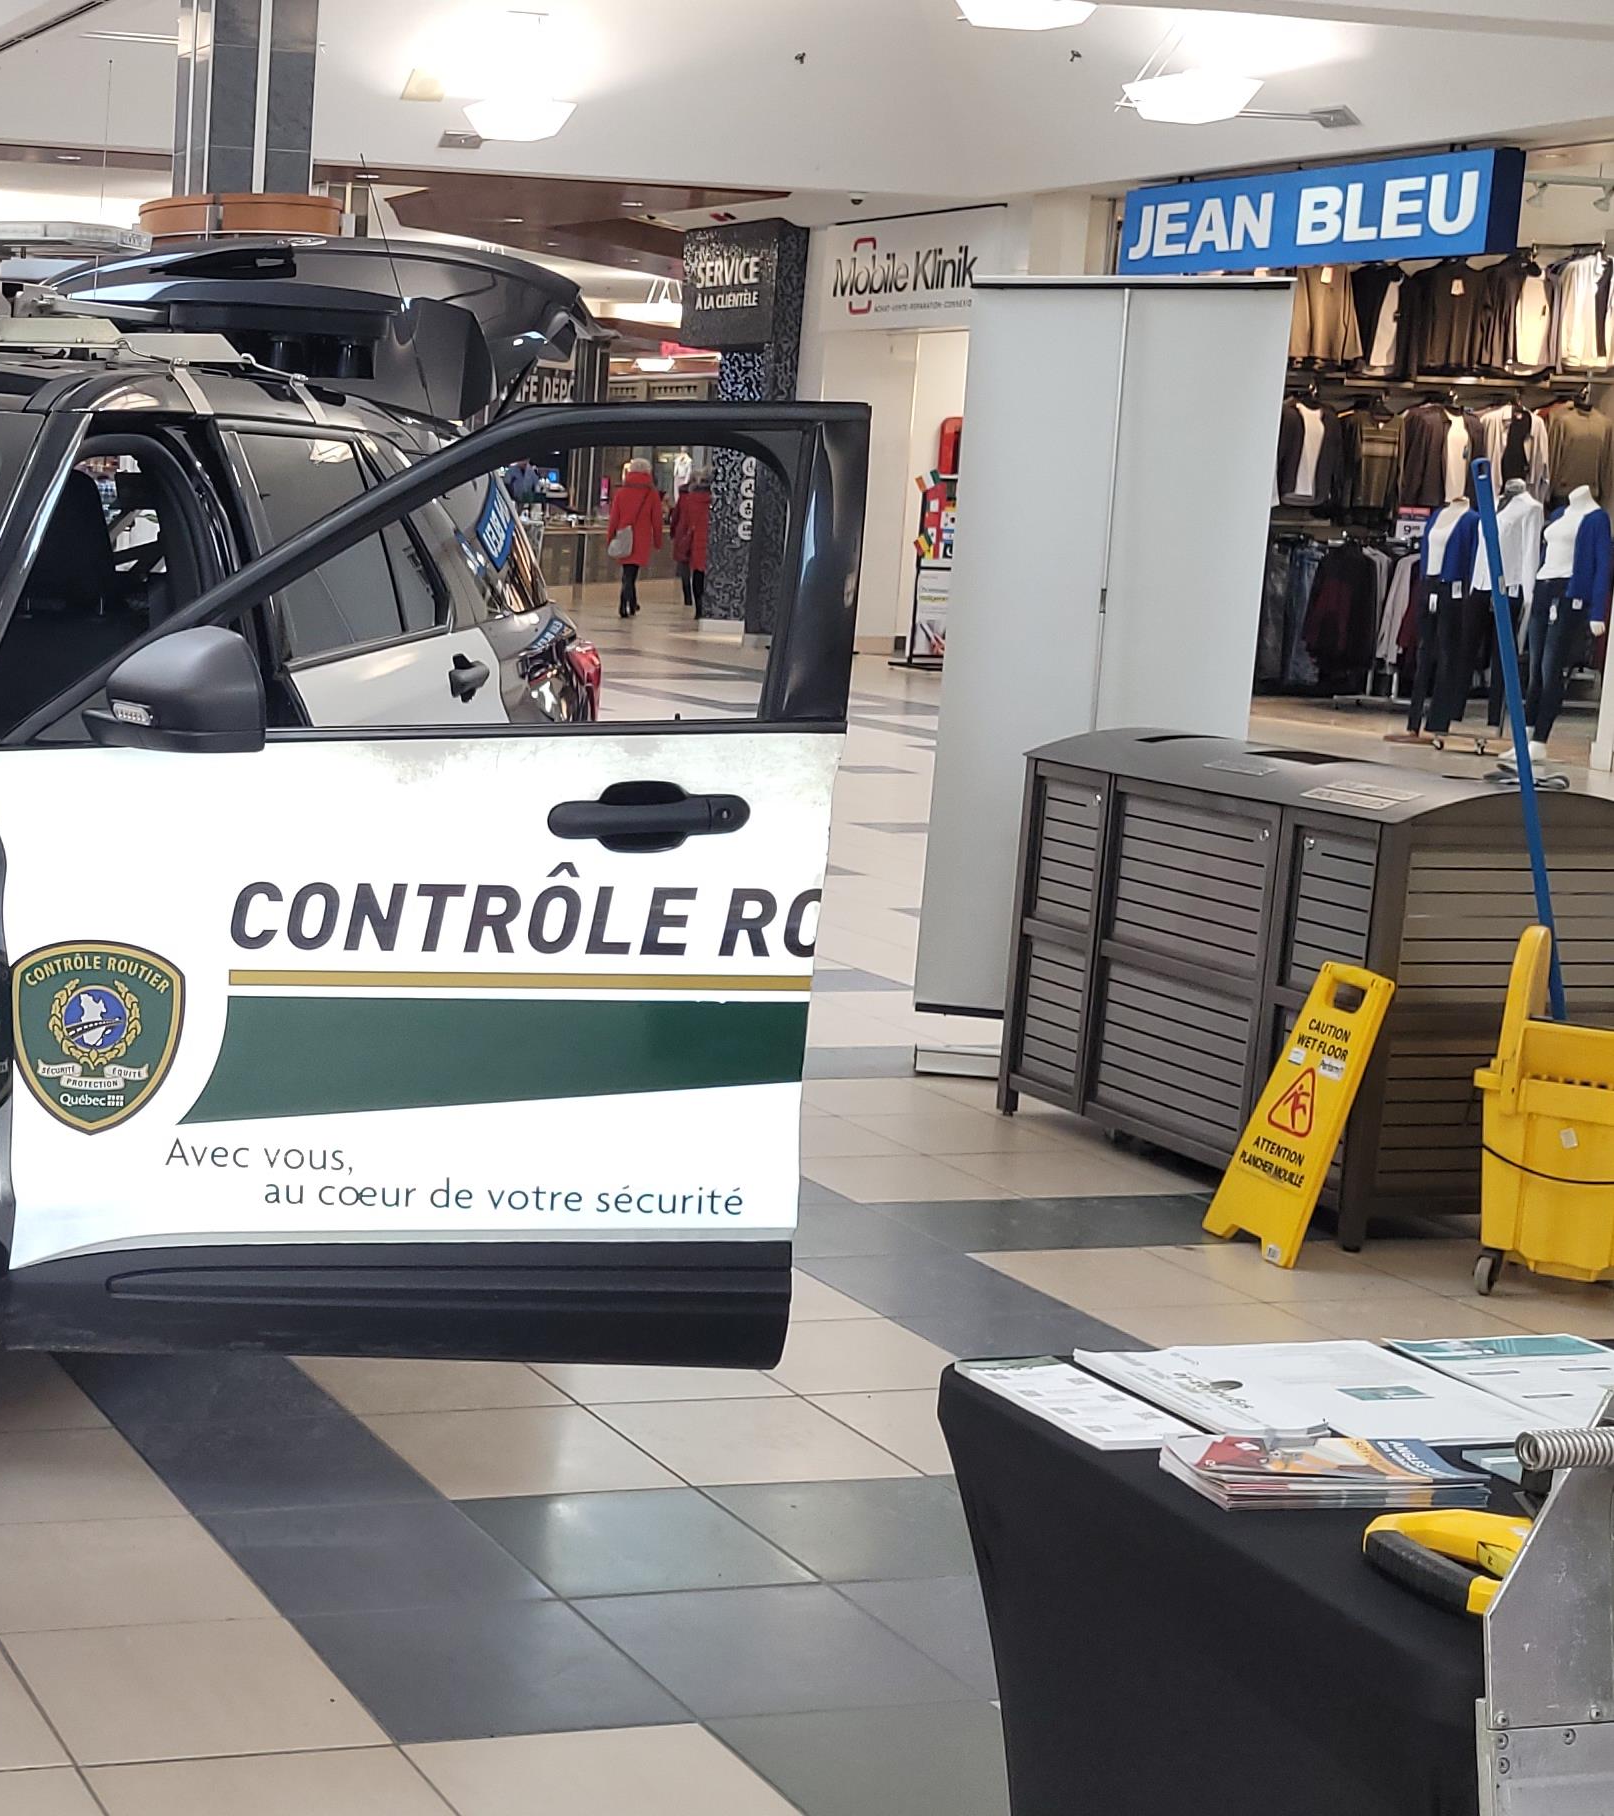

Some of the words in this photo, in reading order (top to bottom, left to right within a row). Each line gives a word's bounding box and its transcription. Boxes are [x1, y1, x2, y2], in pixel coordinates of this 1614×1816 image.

[1128, 193, 1275, 260] JEAN
[1296, 170, 1480, 246] BLEU
[696, 257, 759, 288] SERVICE
[833, 252, 909, 297] Mobile
[913, 245, 978, 291] Klinik
[704, 296, 715, 310] LA
[229, 862, 698, 956] CONTRÔLE
[25, 953, 102, 986] CONTRÔLE
[107, 956, 170, 995] ROUTIER
[1308, 1018, 1351, 1043] CAUTION
[1297, 1033, 1317, 1050] WET
[1316, 1040, 1349, 1062] FLOOR
[41, 1065, 76, 1075] SÉCURITÉ
[66, 1077, 118, 1088] PROTECTION
[59, 1093, 106, 1107] Québec
[165, 1137, 250, 1169] Avec
[264, 1147, 354, 1175] vous,
[1239, 1150, 1275, 1174] PLANCHER
[1253, 1135, 1305, 1167] ATTENTION
[264, 1182, 304, 1205] au
[318, 1184, 417, 1208] cœur
[430, 1177, 473, 1210] de
[487, 1186, 583, 1213] votre
[595, 1184, 744, 1216] sécurité
